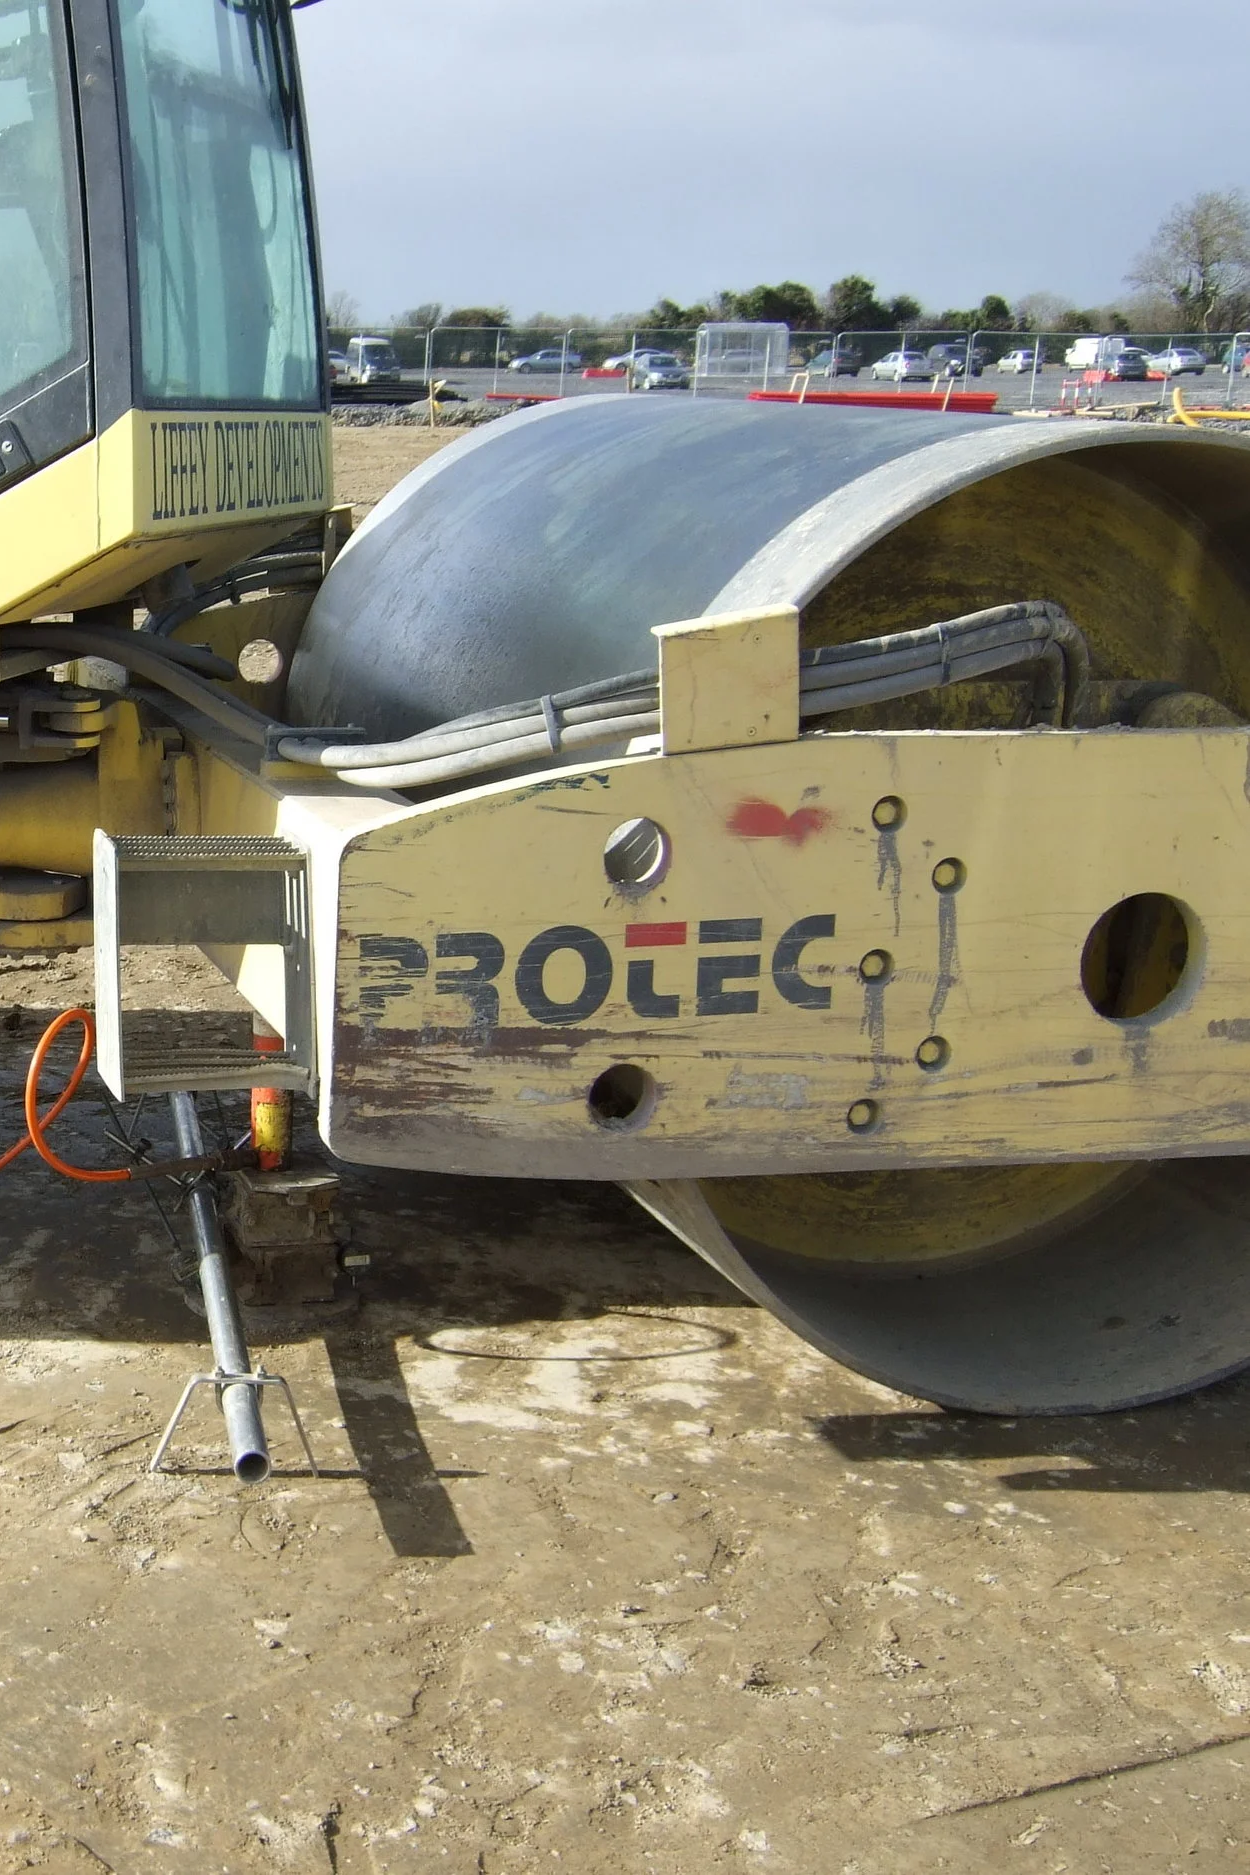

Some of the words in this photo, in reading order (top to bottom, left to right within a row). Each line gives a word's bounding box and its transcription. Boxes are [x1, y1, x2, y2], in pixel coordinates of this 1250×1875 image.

[151, 422, 209, 520] LIFFEY
[214, 420, 325, 512] DEVELOPMENTS
[359, 914, 836, 1026] PROTEC
